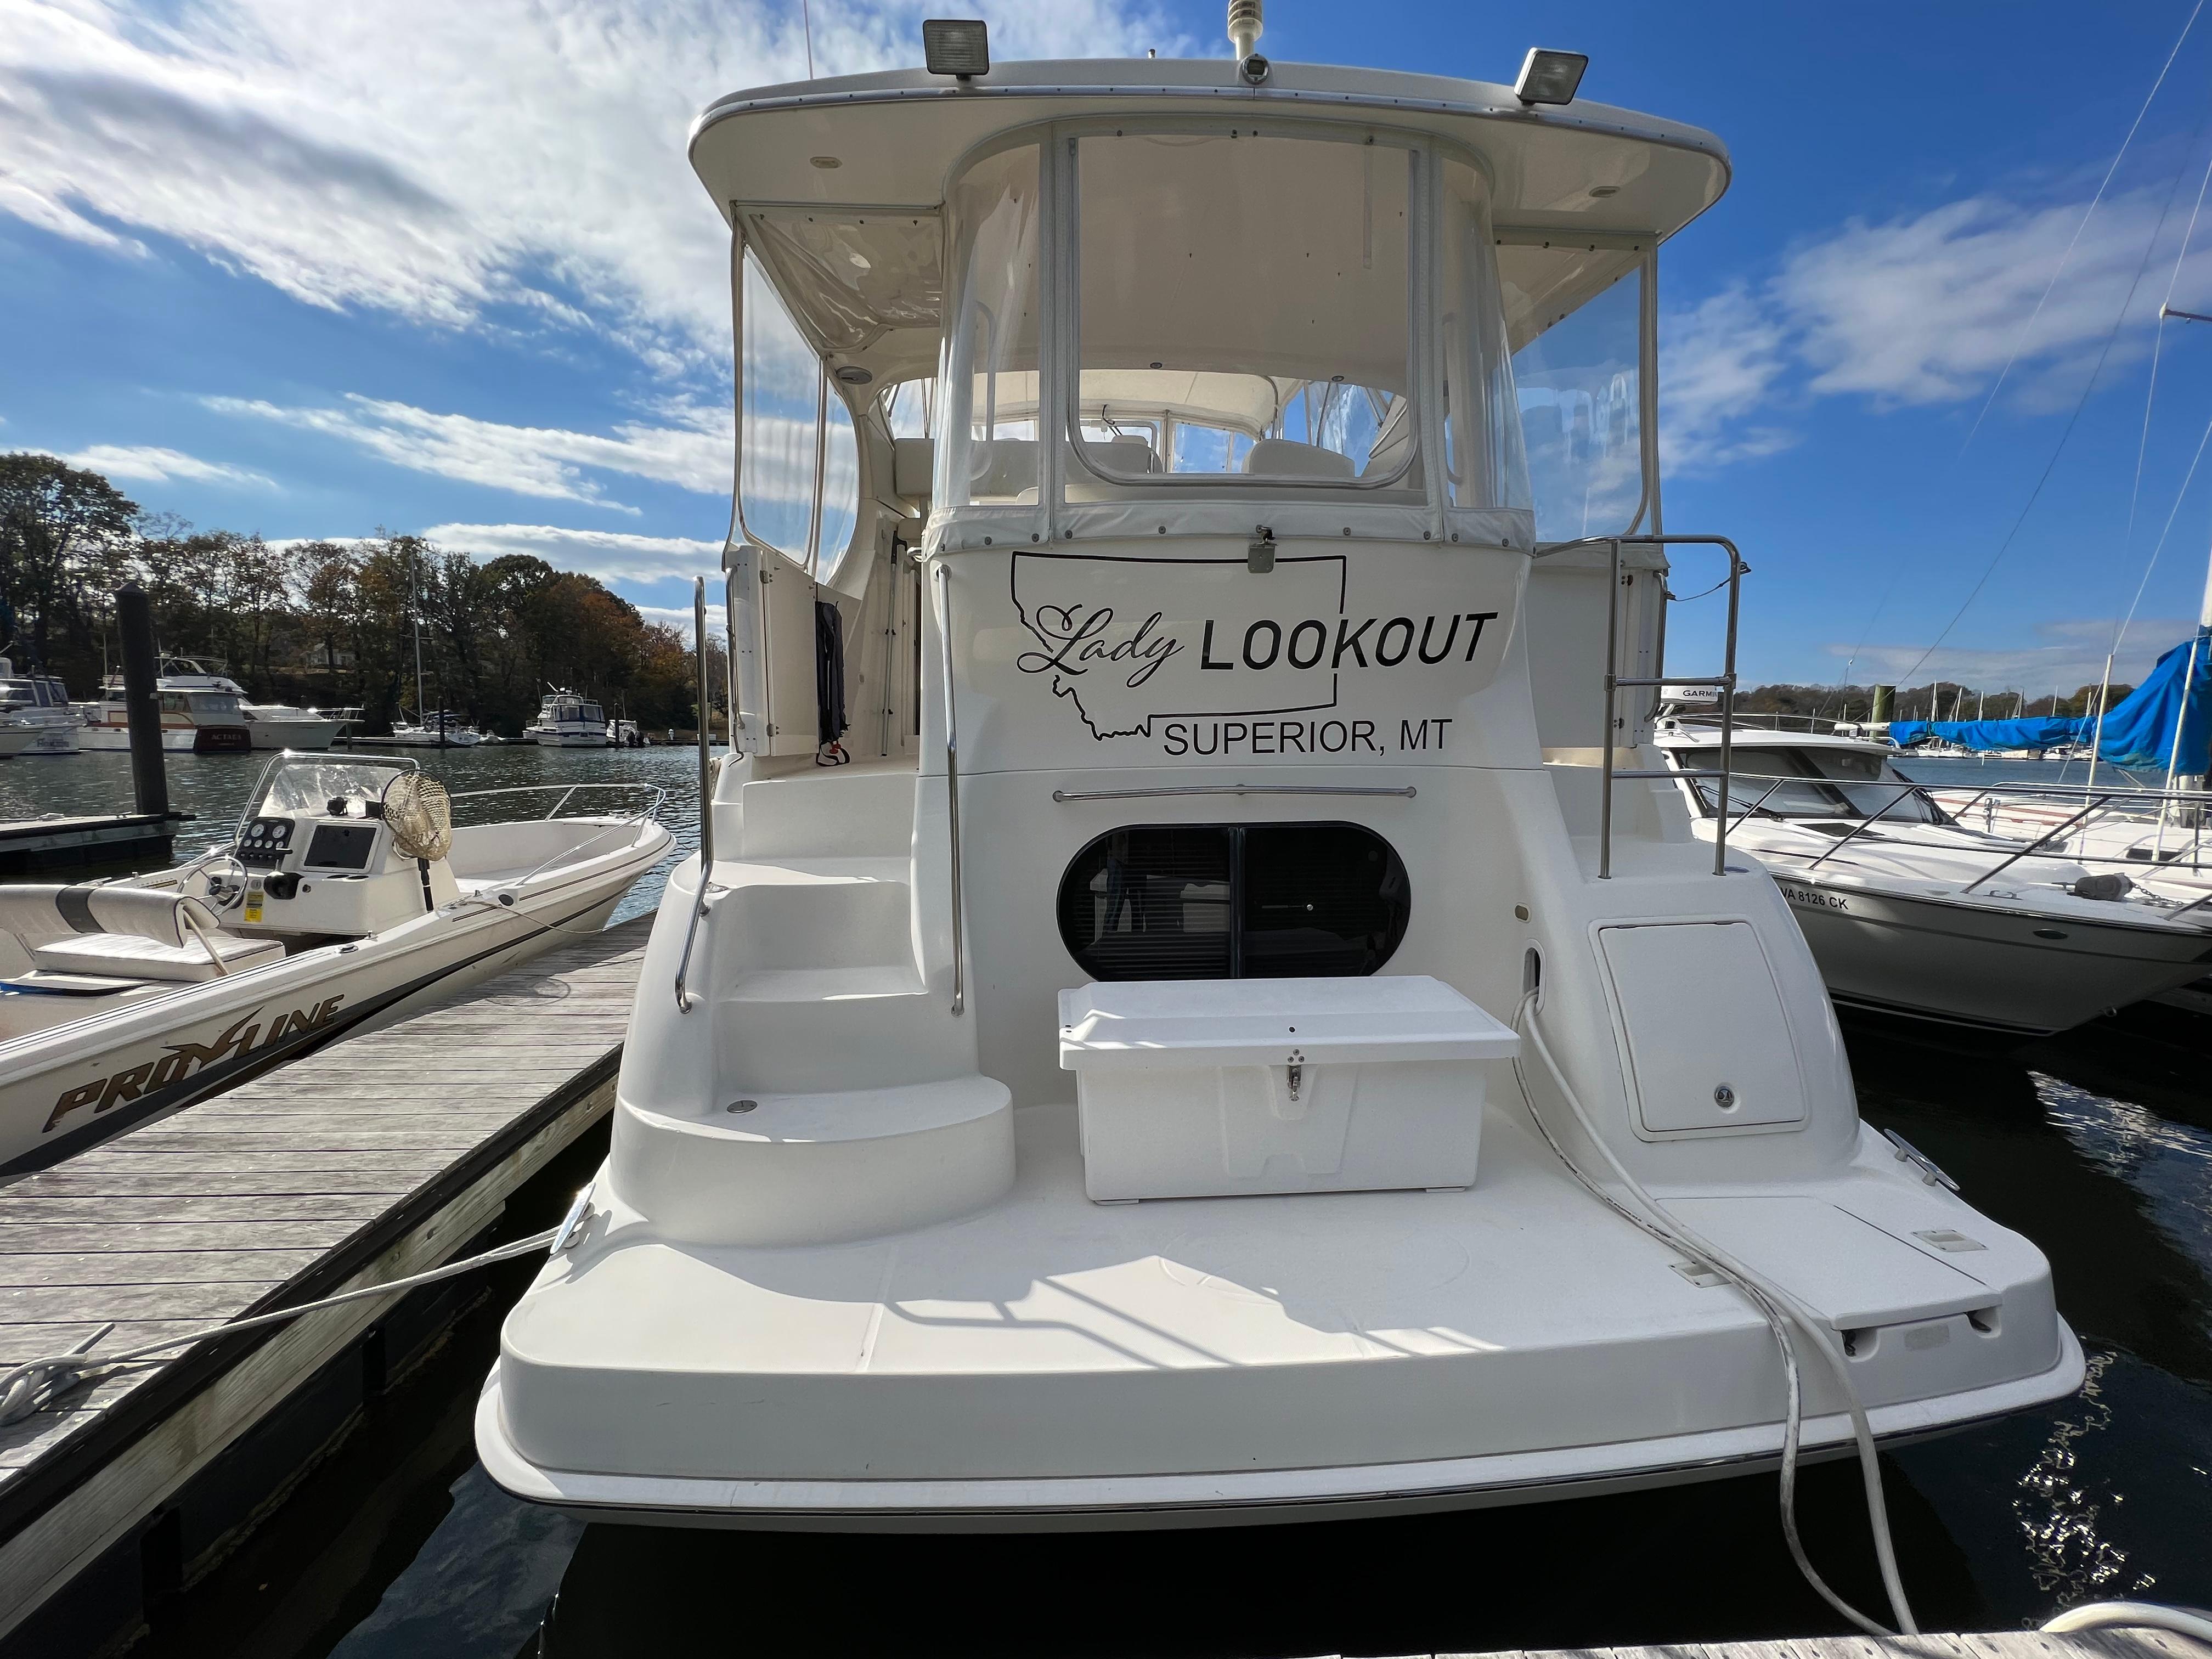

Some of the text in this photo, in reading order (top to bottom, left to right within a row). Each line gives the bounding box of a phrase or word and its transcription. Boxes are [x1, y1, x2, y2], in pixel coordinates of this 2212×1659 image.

[1017, 604, 1499, 688] Lady LOOKOUT
[1164, 719, 1453, 757] SUPERIOR, MT
[1780, 887, 1849, 910] VA 8126 CK
